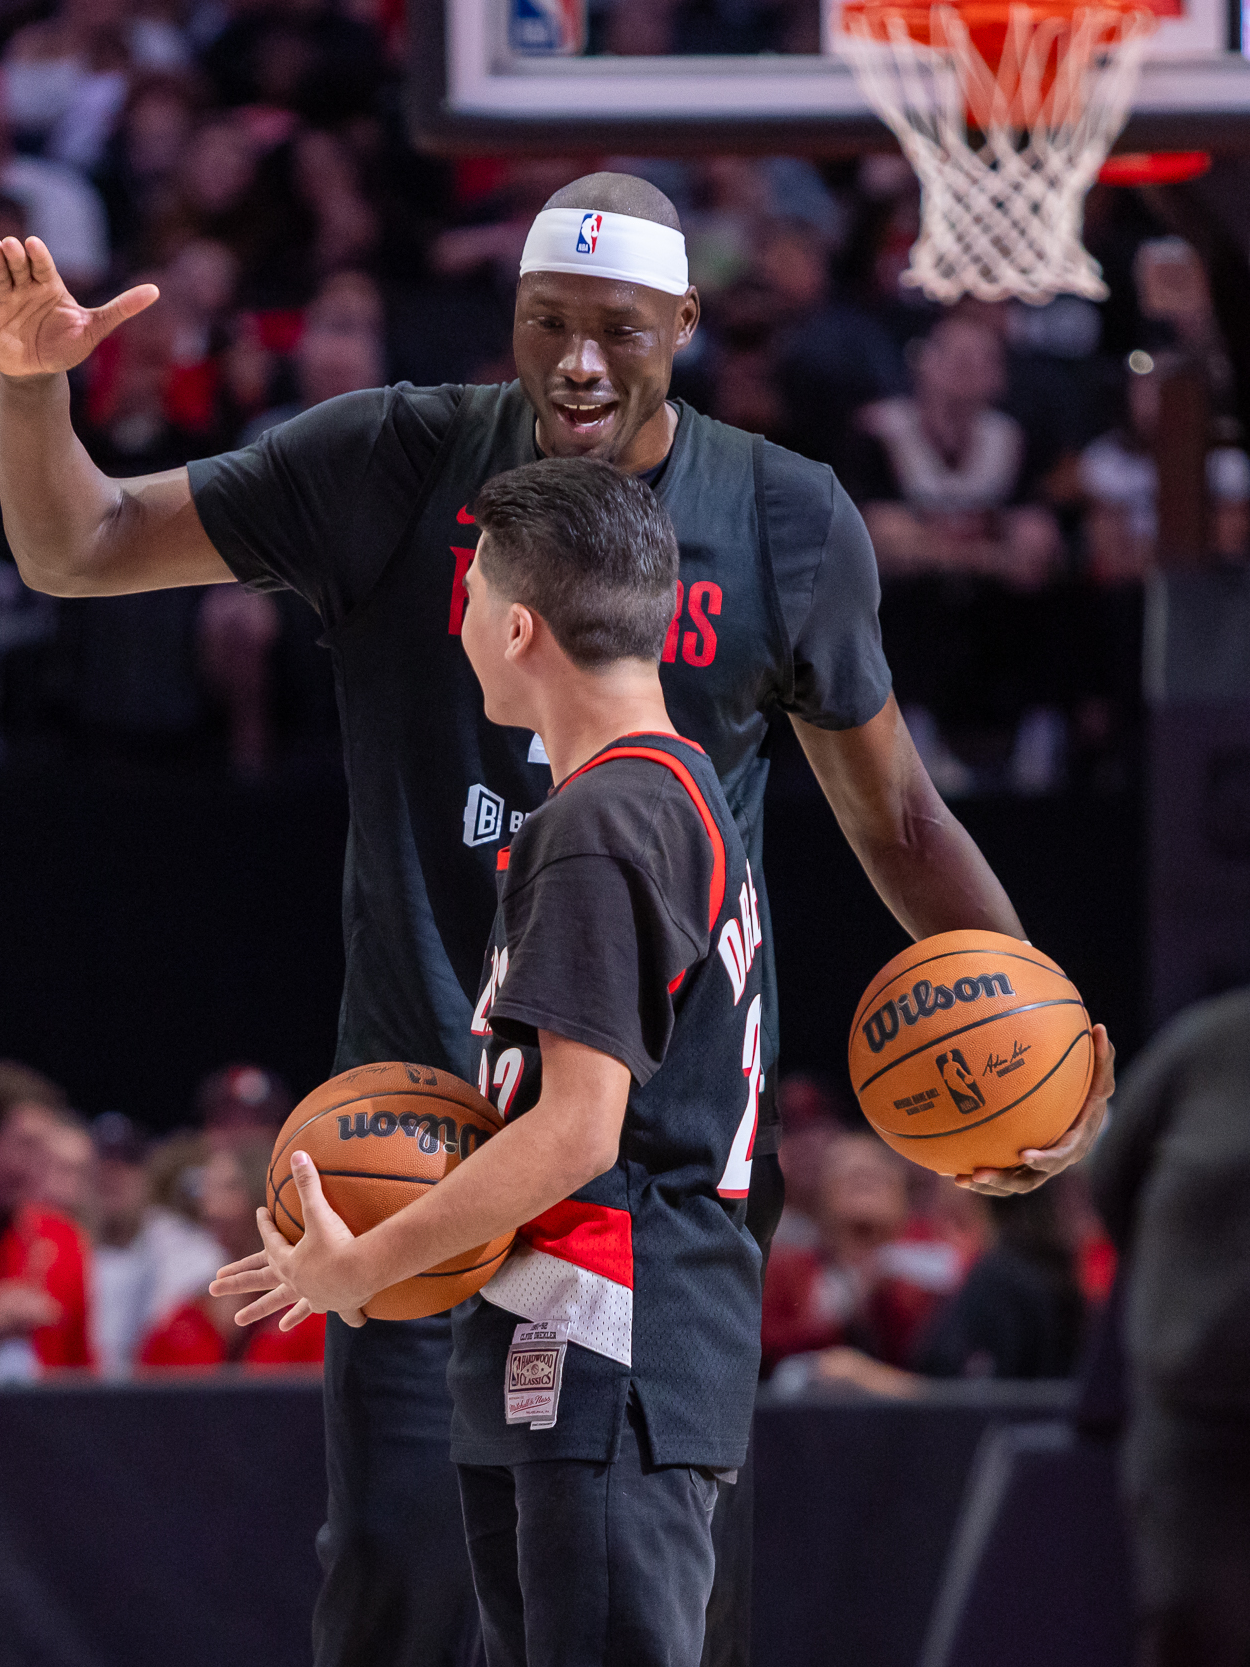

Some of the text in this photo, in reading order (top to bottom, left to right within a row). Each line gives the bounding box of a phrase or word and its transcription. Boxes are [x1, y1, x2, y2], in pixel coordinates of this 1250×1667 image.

[862, 972, 1017, 1054] Wilson
[533, 1331, 557, 1340] DREXLER
[521, 1353, 554, 1371] HARDWOOD
[520, 1371, 552, 1386] CLASSICS
